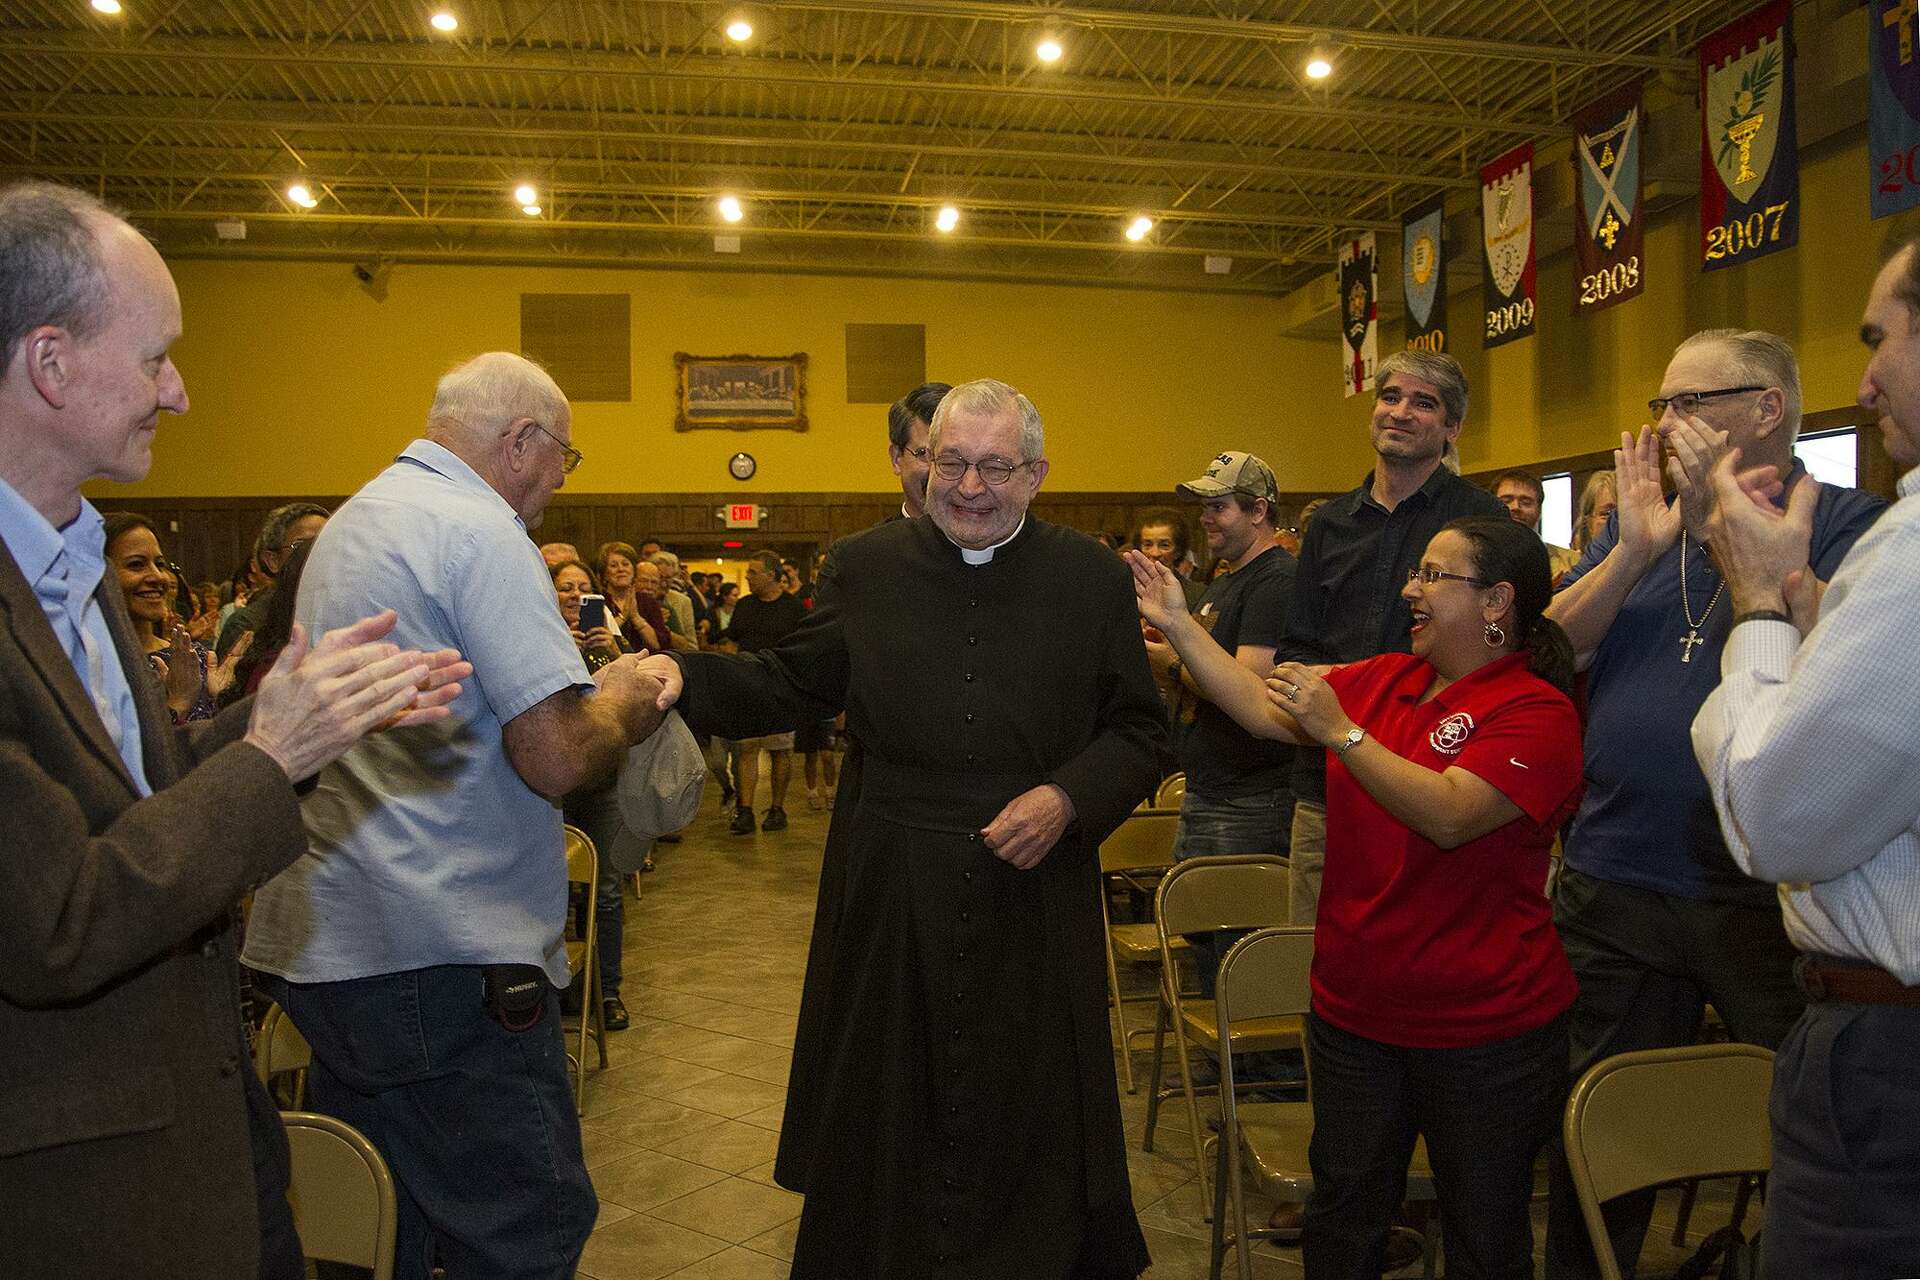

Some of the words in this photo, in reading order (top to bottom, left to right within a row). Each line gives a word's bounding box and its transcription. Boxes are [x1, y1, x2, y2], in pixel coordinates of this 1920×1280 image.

[1705, 201, 1789, 260] 2007
[1580, 256, 1639, 305] 2008
[1486, 297, 1535, 338] 2009
[732, 506, 753, 521] EXIT
